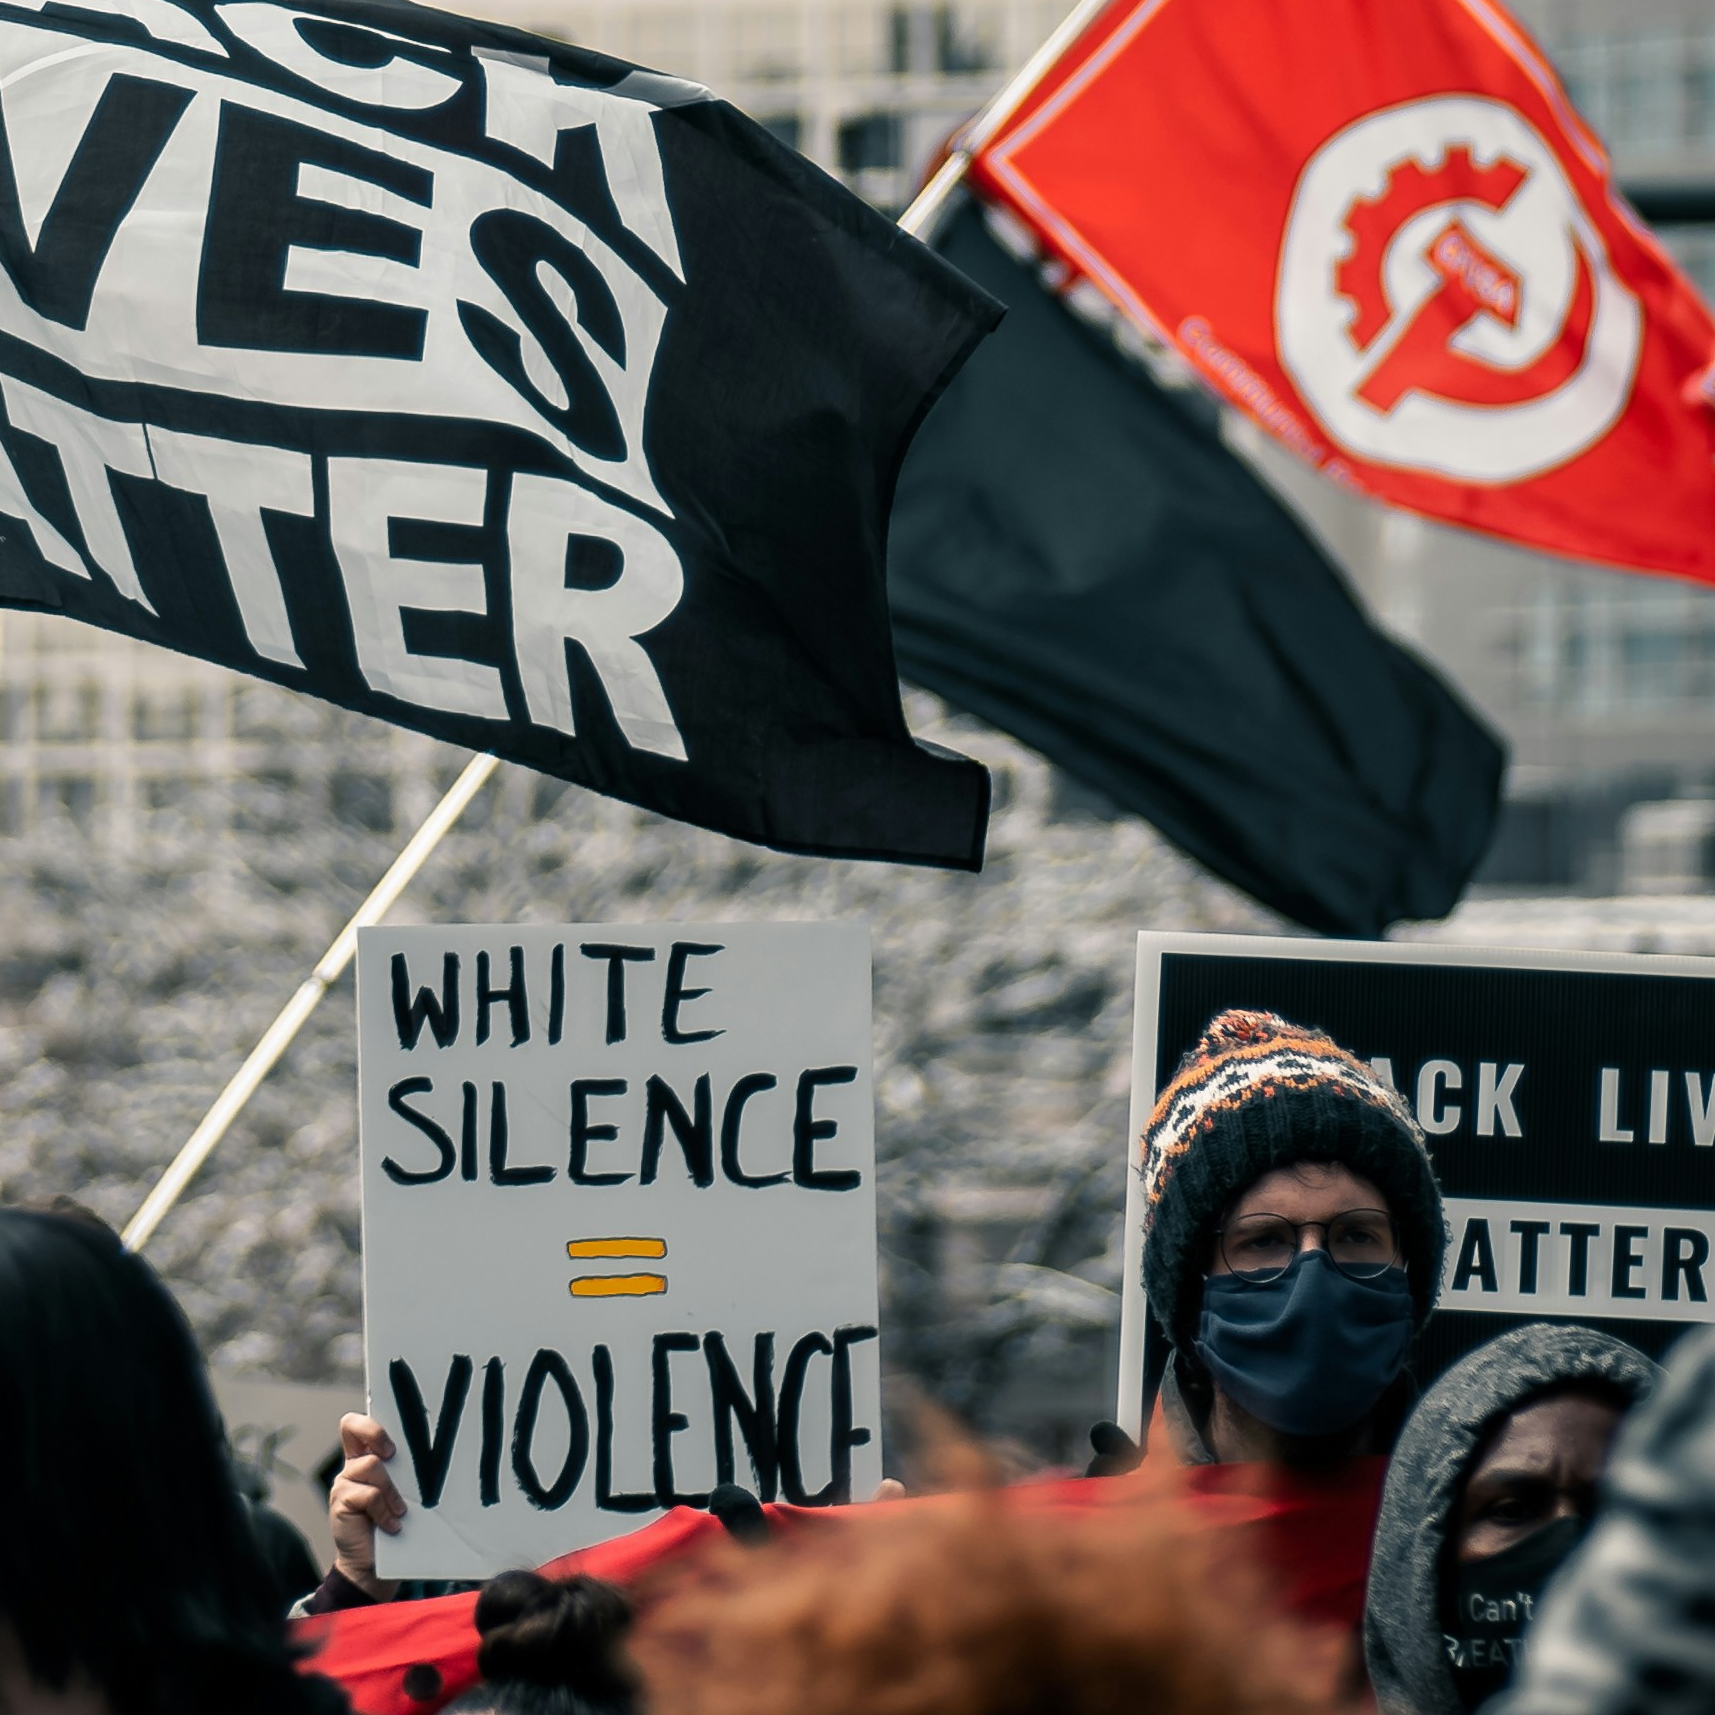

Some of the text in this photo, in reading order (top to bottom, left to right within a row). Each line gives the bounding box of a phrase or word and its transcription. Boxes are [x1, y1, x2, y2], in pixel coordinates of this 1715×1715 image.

[389, 941, 727, 1050] WHITE
[380, 1064, 863, 1191] SILENCE
[1450, 1216, 1710, 1304] ATTER
[388, 1323, 879, 1514] VIOLENCE
[1441, 1632, 1526, 1669] REAT
[1468, 1590, 1535, 1623] Can't
